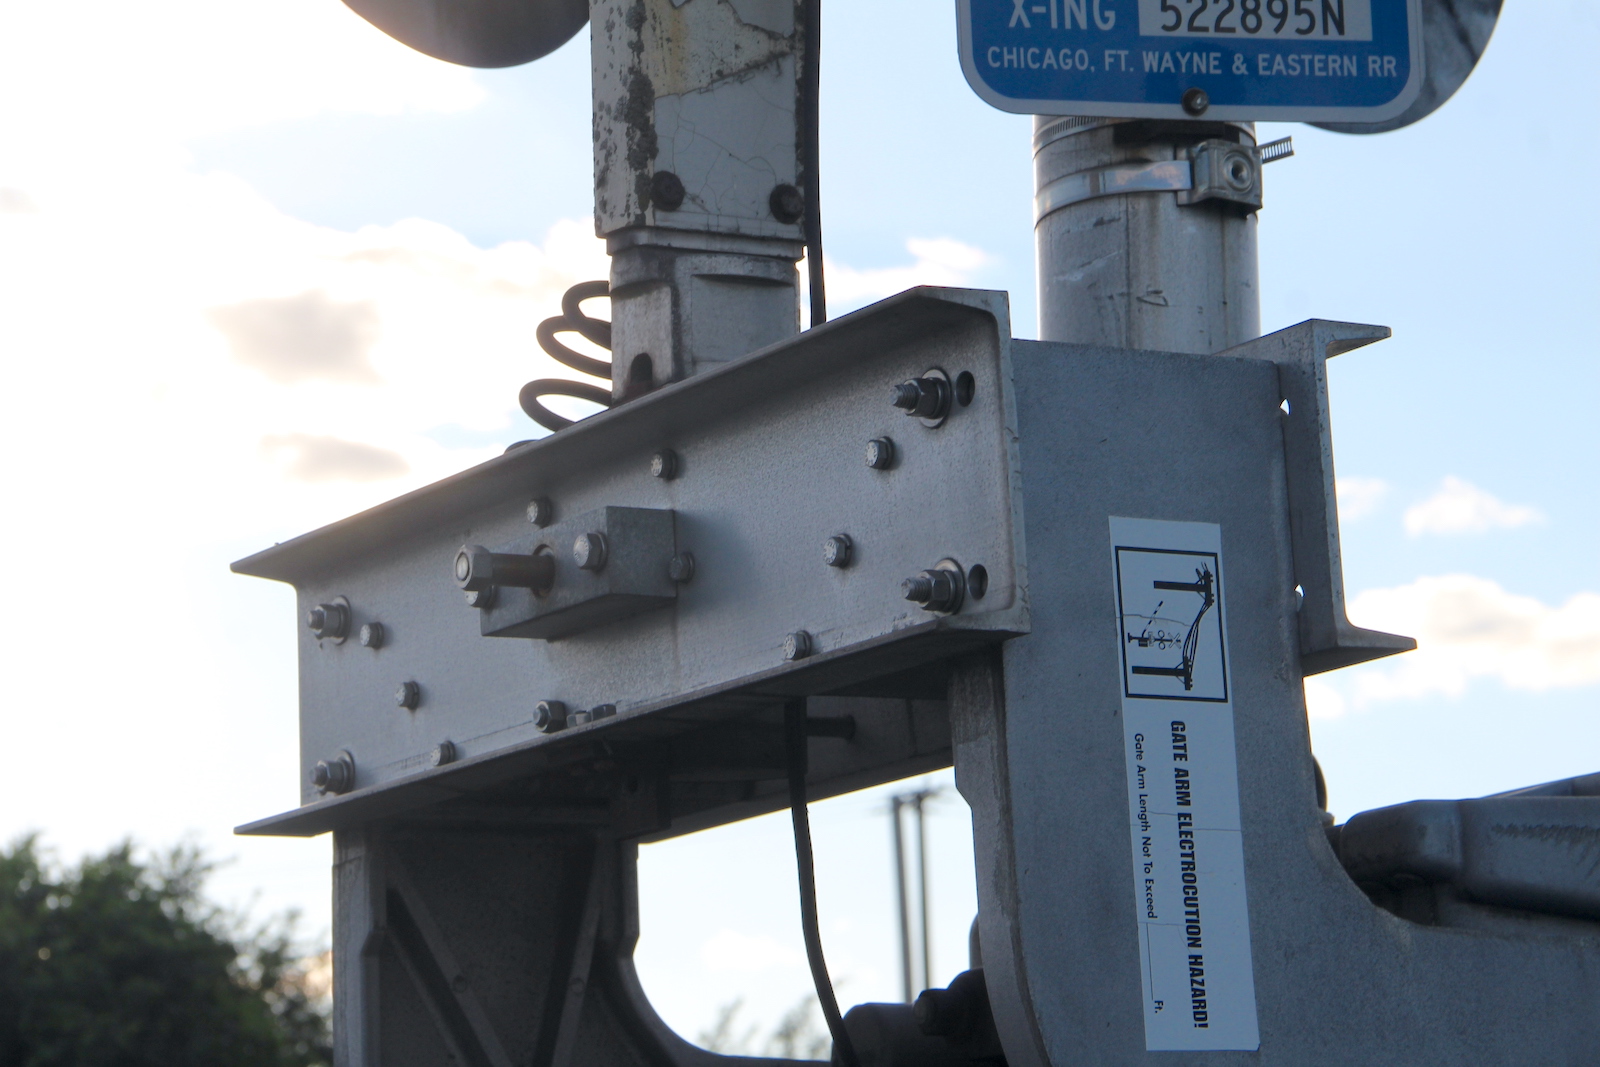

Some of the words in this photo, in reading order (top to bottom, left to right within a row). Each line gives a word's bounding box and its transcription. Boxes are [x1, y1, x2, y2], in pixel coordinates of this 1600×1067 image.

[1008, 0, 1116, 31] X-ING
[1160, 0, 1345, 36] 522895N
[987, 46, 1095, 73] CHICAGO,
[1104, 51, 1134, 72] FT.
[1142, 51, 1222, 75] WAYNE
[1232, 53, 1249, 75] &
[1258, 54, 1358, 76] EASTERN
[1368, 56, 1397, 77] RR
[1134, 733, 1145, 761] Gate
[1171, 720, 1188, 762] GATE
[1136, 764, 1147, 790] Arm
[1174, 767, 1192, 807] ARM
[1137, 793, 1152, 832] Length
[1141, 836, 1152, 858] Not
[1143, 861, 1154, 874] To
[1177, 812, 1202, 949] ELECTROCUTION
[1144, 878, 1158, 919] Exceed
[1153, 1000, 1164, 1014] Ft.
[1188, 954, 1209, 1029] HAZARD!
